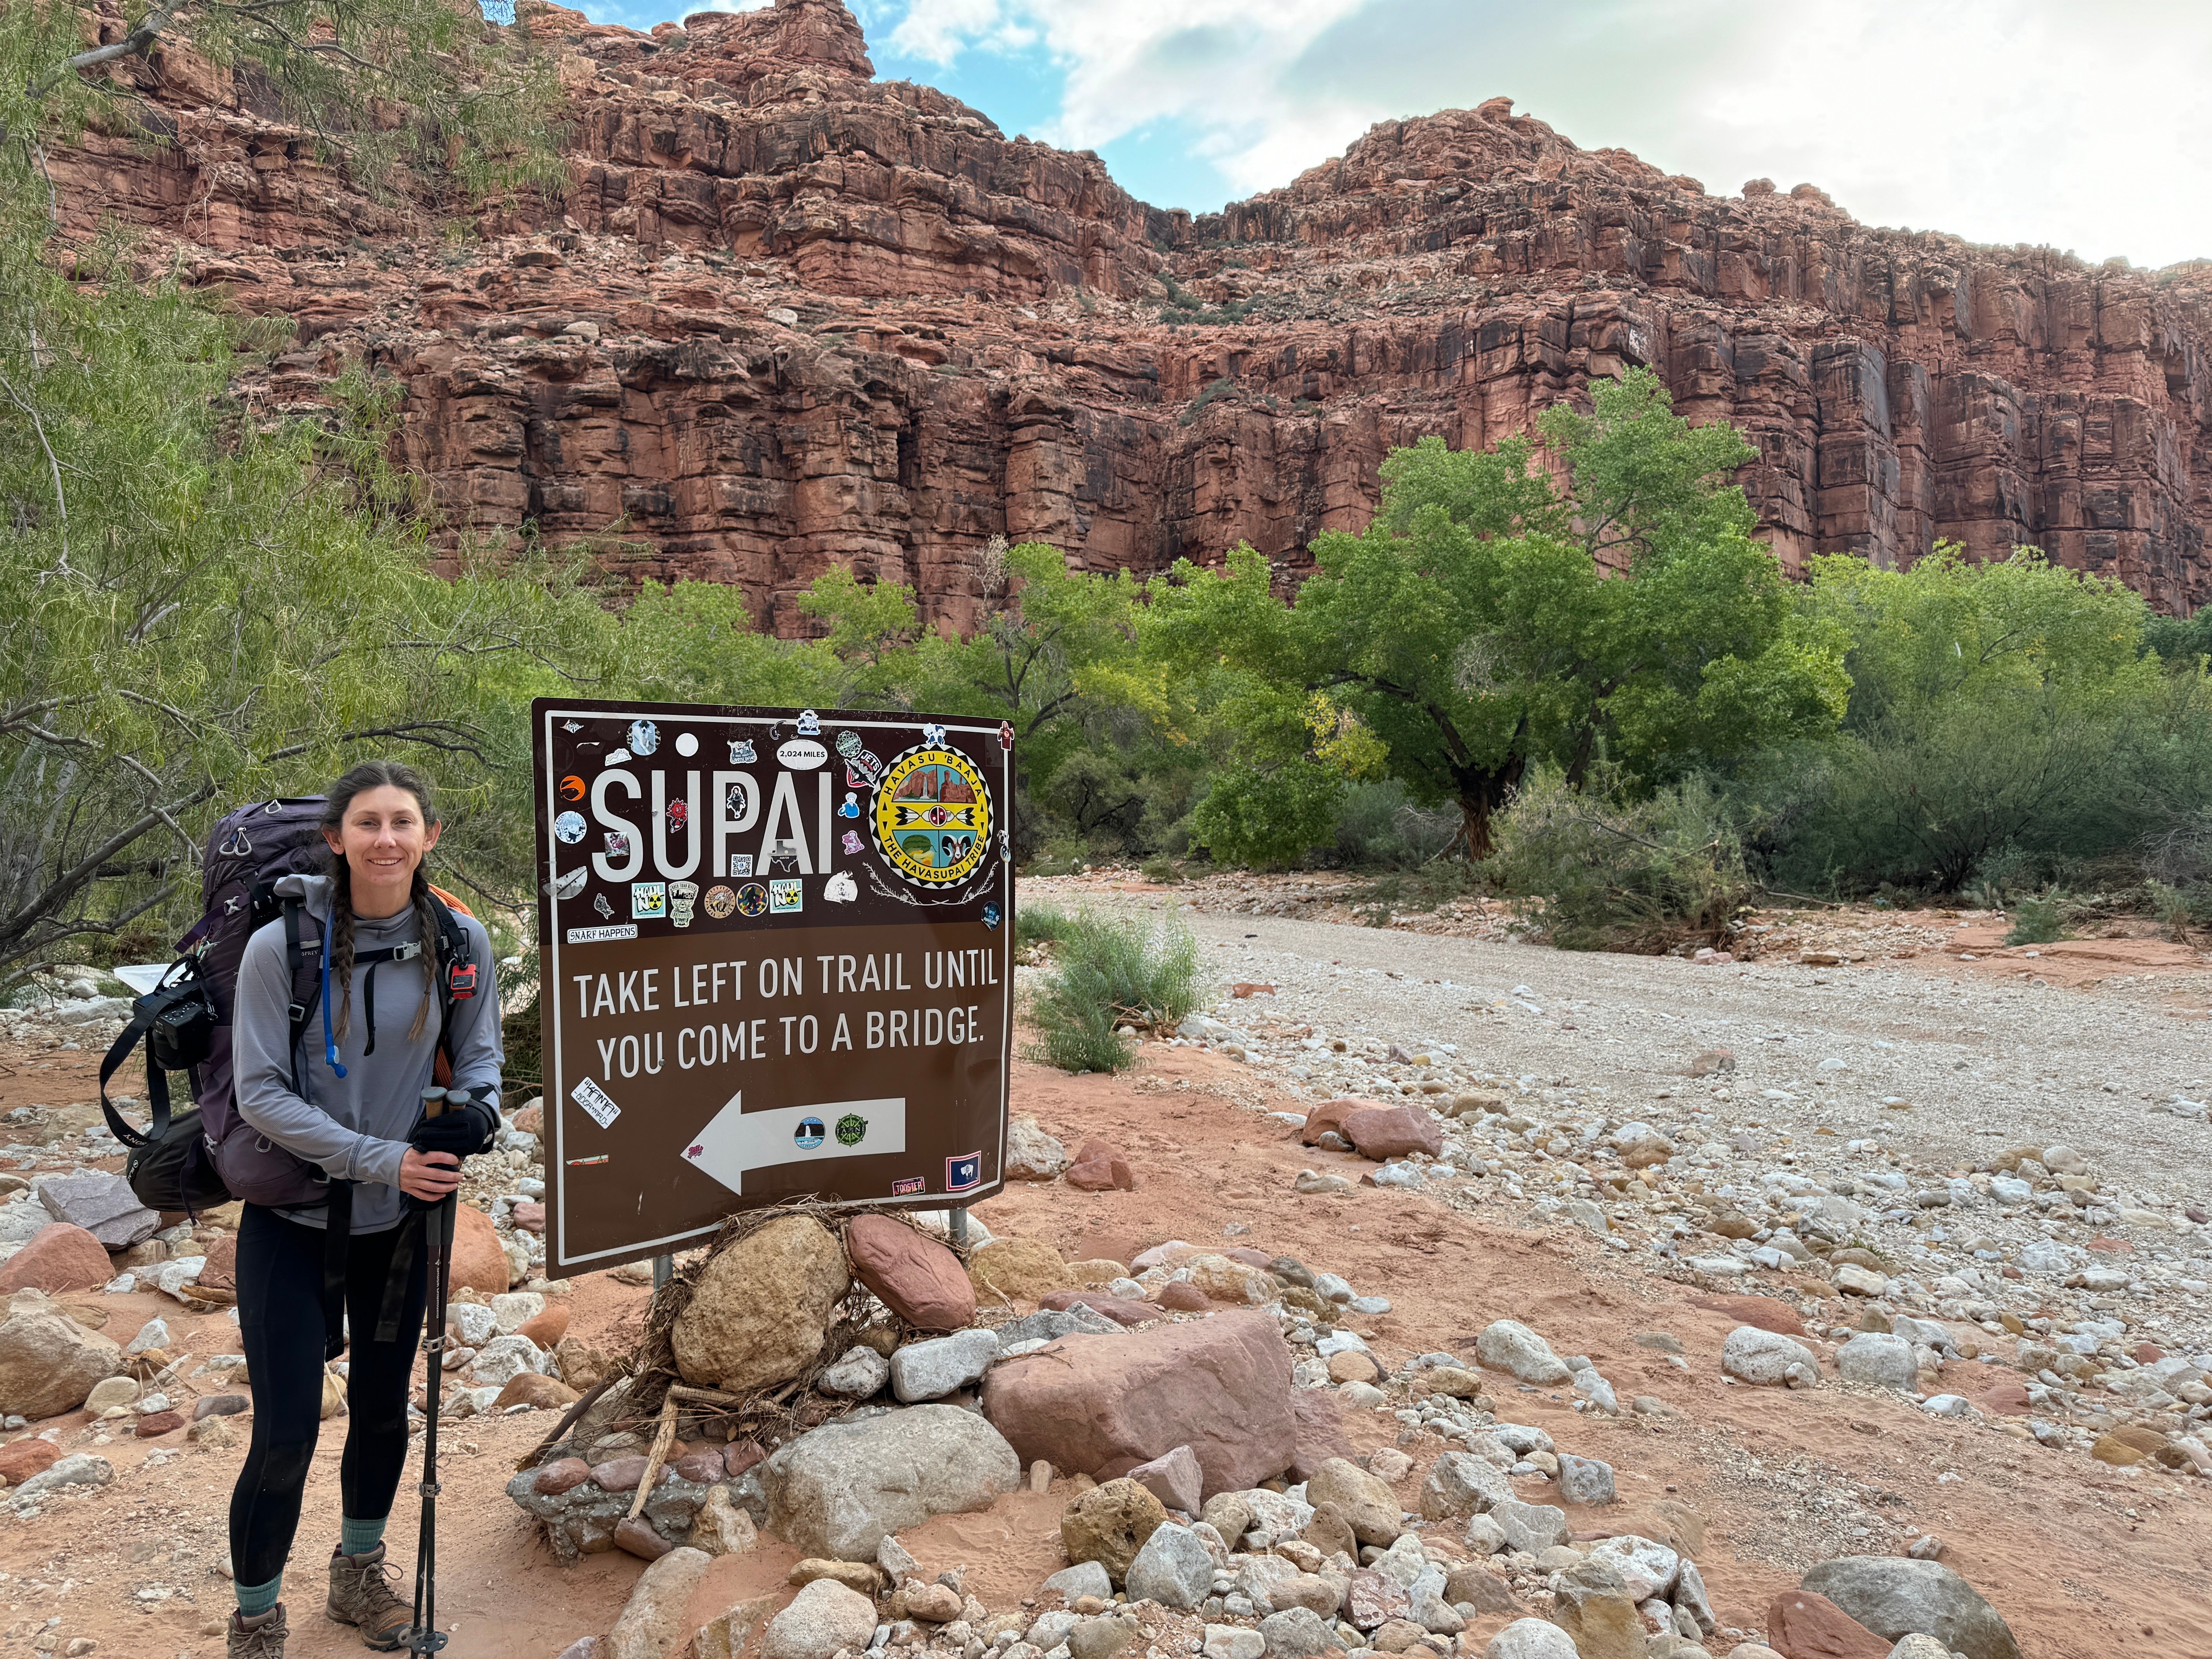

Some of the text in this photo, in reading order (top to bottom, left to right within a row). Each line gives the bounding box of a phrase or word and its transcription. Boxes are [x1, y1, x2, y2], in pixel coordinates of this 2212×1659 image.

[861, 753, 879, 771] JETS
[884, 754, 935, 795] HAVASU
[591, 769, 831, 883] SUPAI
[884, 835, 984, 879] THE HAVASUPAI TRIBE
[634, 885, 664, 899] HAUL
[771, 881, 801, 896] HAUL
[570, 927, 635, 941] SNARF HAPPENS
[574, 948, 998, 1018] TAKE LEFT ON TRAIL UNTIL
[597, 1005, 984, 1080] YOU COME TO A BRIDGE.
[896, 1182, 923, 1192] TOOSTER
